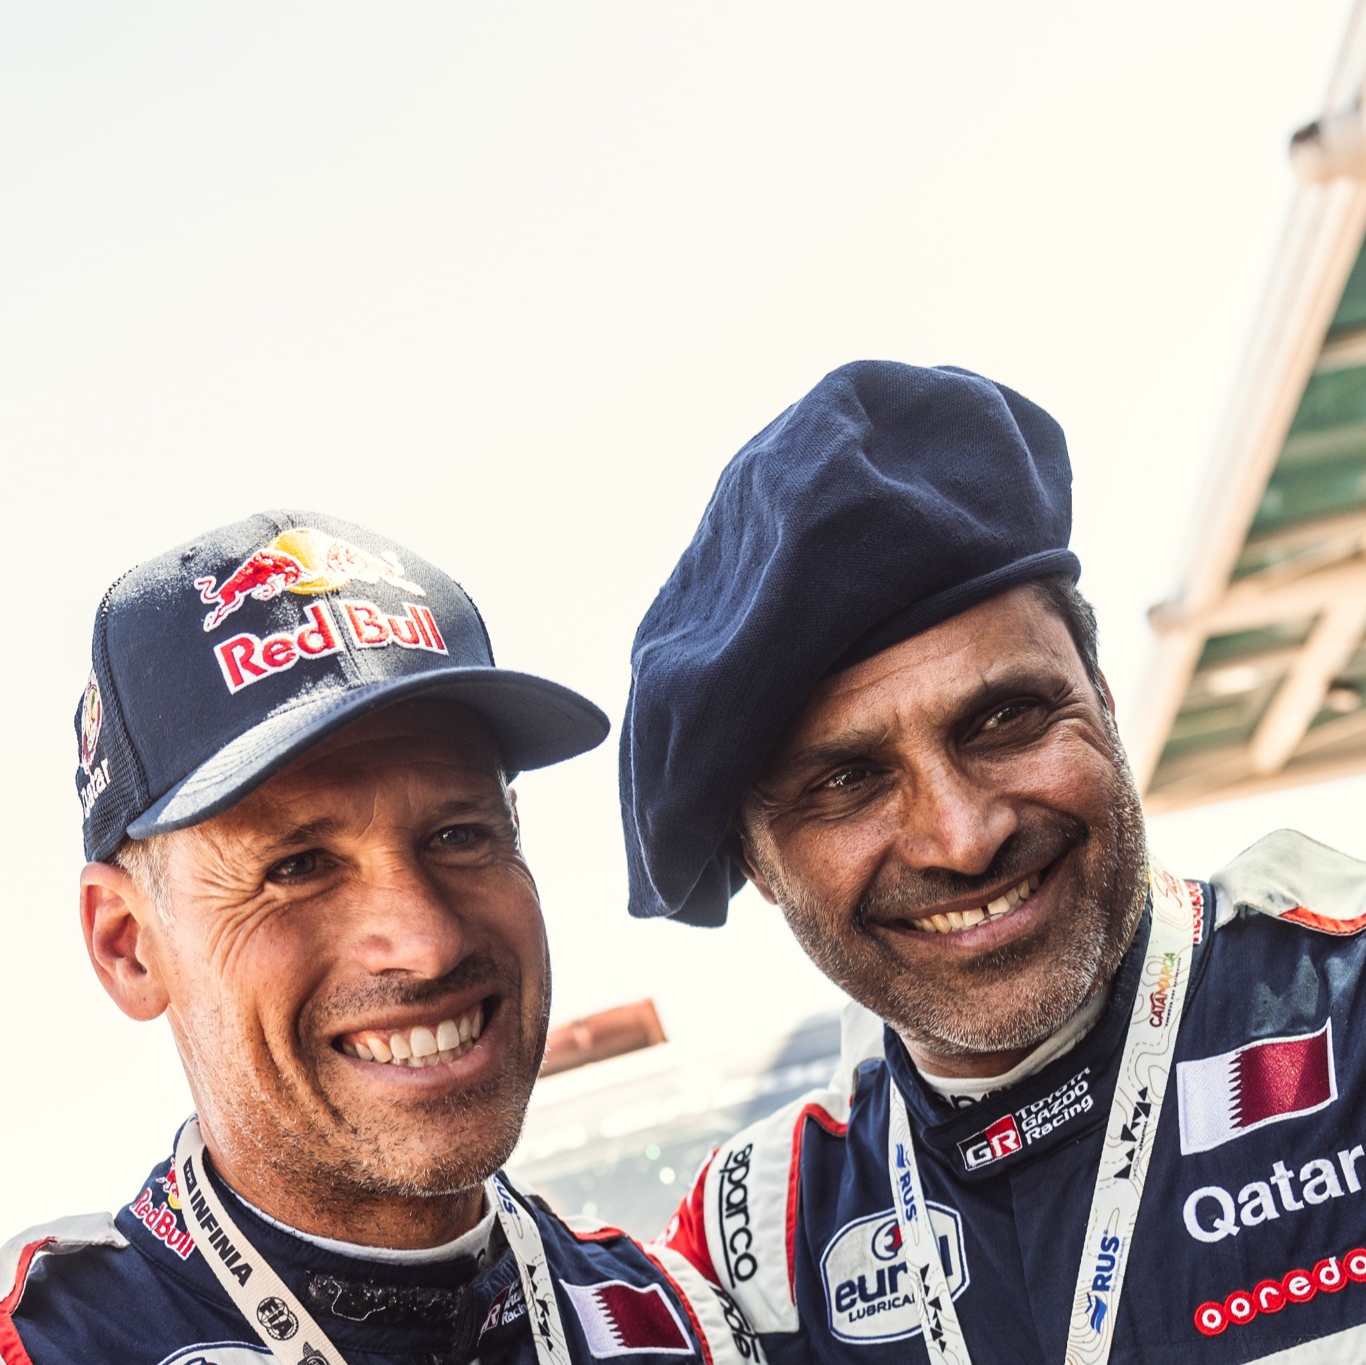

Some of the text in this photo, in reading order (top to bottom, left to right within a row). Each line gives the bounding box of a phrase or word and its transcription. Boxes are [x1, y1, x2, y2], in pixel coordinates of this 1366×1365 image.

[219, 602, 447, 690] Red Bull
[1149, 952, 1176, 1028] CATAMARCA
[1021, 1080, 1089, 1132] GAZOO
[1025, 1094, 1094, 1145] Racing
[965, 1128, 1018, 1166] GR
[130, 1188, 197, 1258] Red Bull
[492, 1174, 518, 1216] US
[719, 1142, 758, 1282] sparco
[899, 1170, 918, 1222] RUS
[190, 1188, 254, 1288] INFINIA
[1091, 1236, 1121, 1292] RUS
[834, 1234, 954, 1314] eurl
[848, 1292, 916, 1323] LUBRICA
